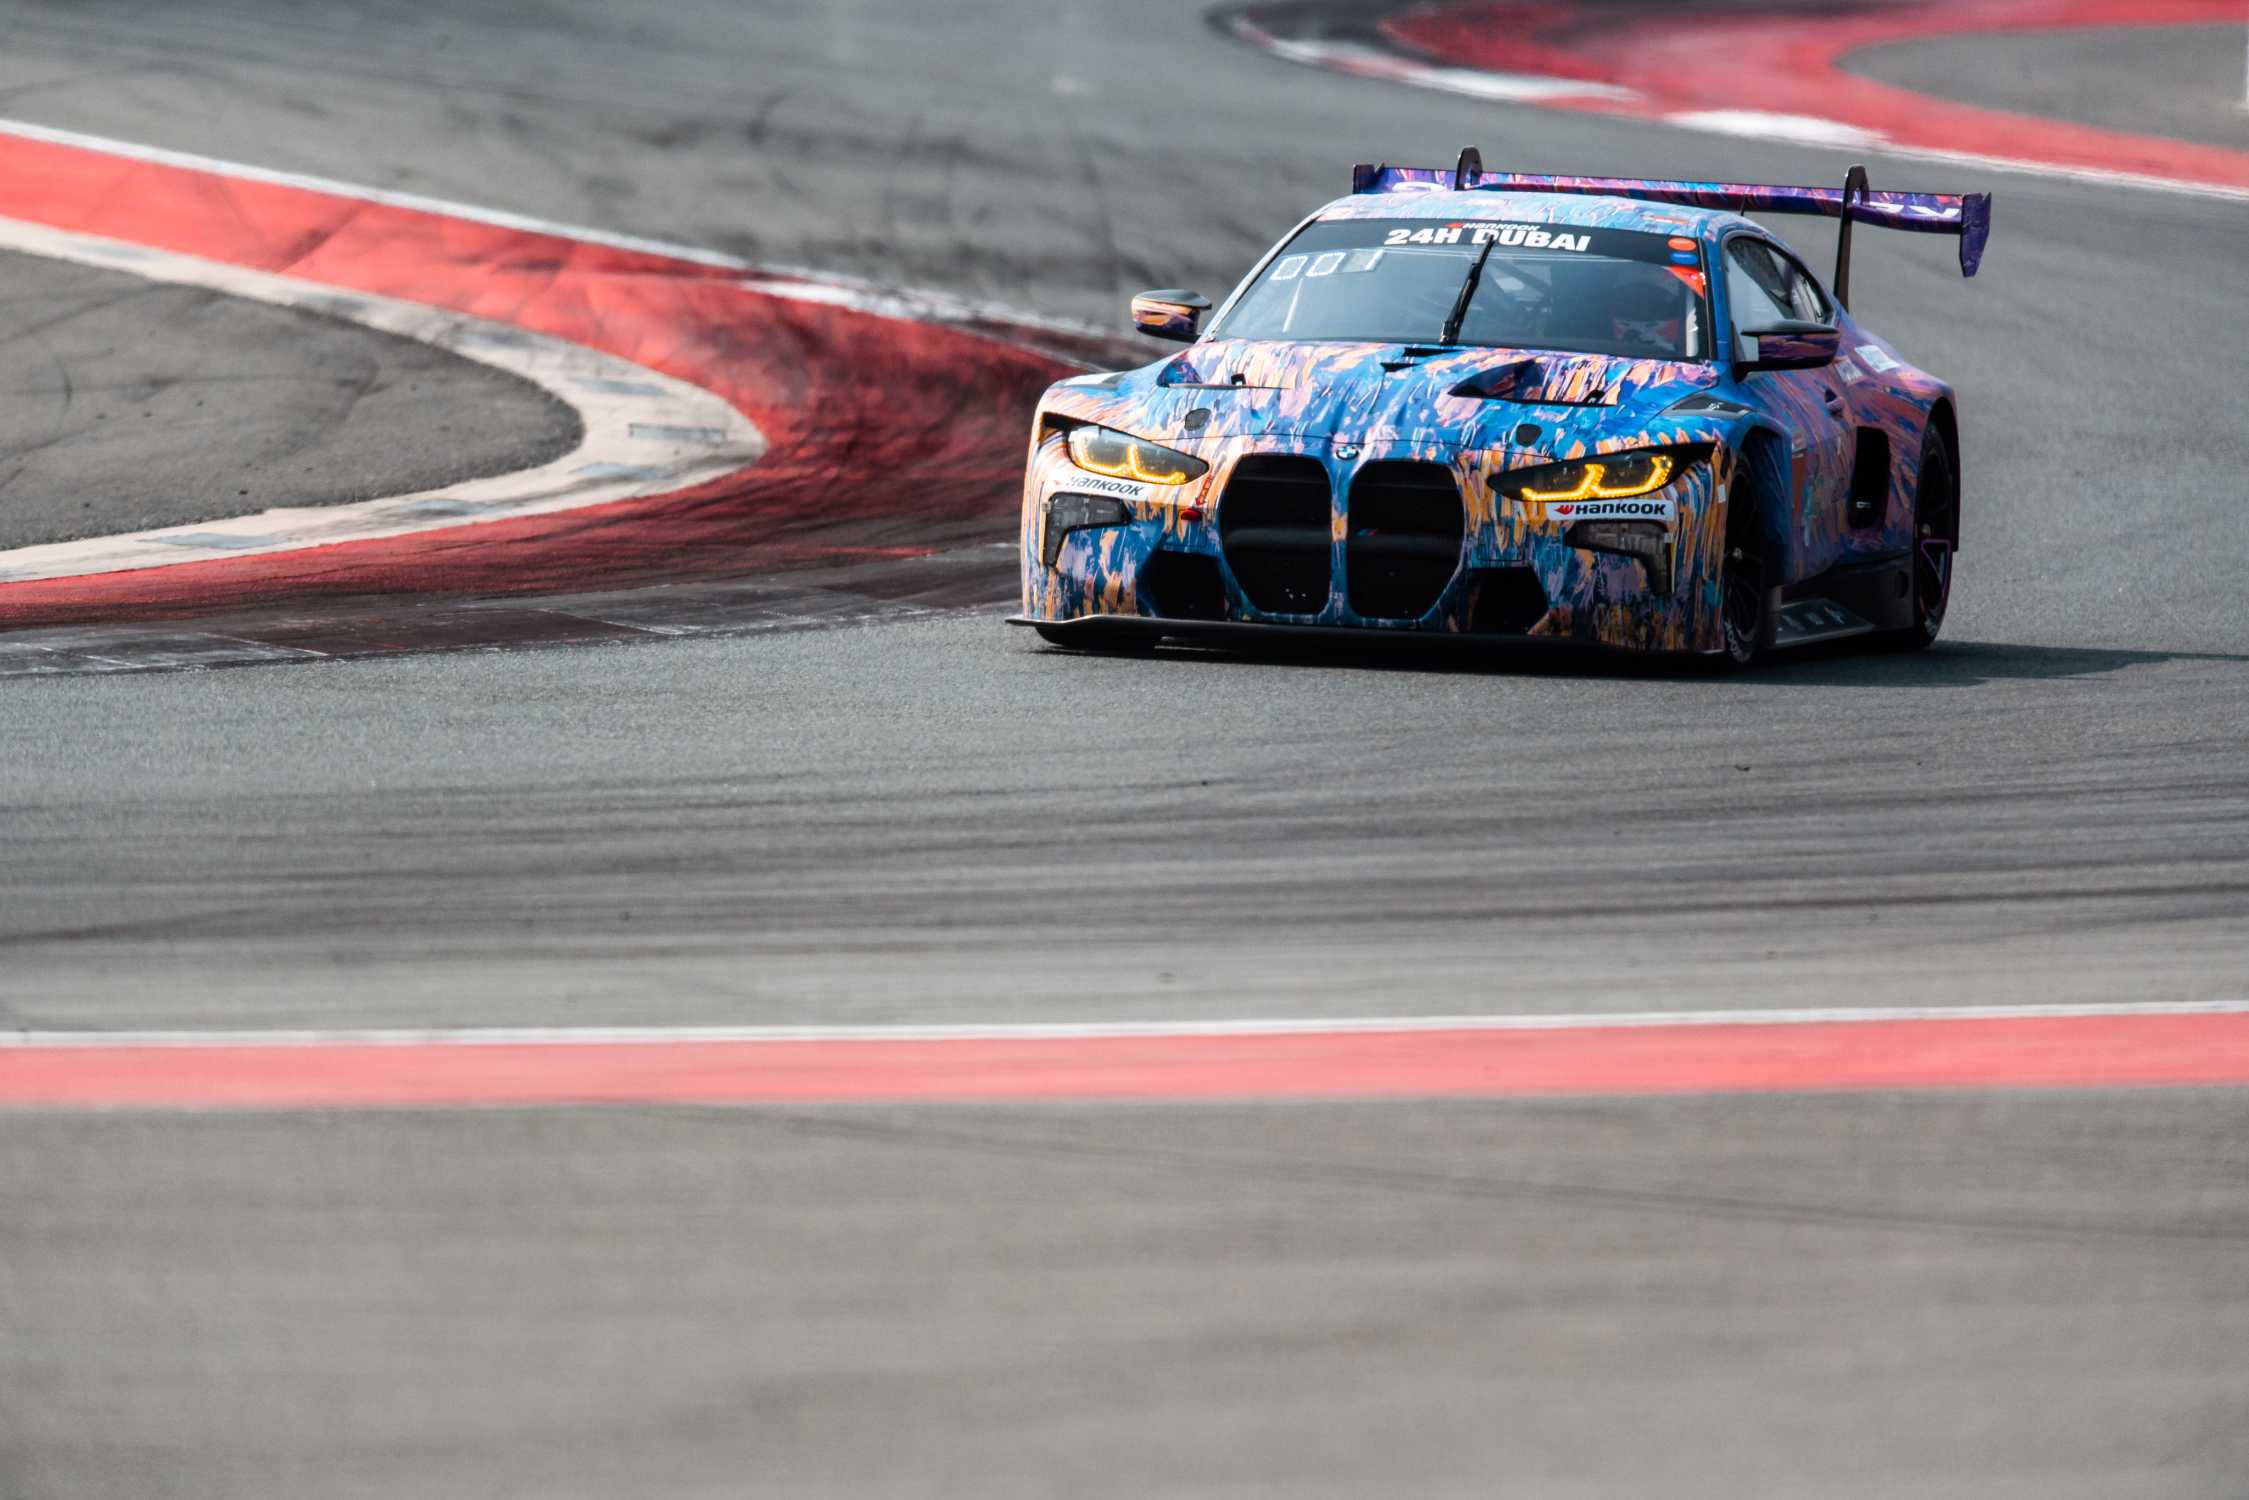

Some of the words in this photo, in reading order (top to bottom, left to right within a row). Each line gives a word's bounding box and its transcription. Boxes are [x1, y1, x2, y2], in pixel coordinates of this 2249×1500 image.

[1384, 228, 1462, 245] 24H
[1471, 228, 1591, 252] DUBAI
[1575, 502, 1667, 515] Hankook
